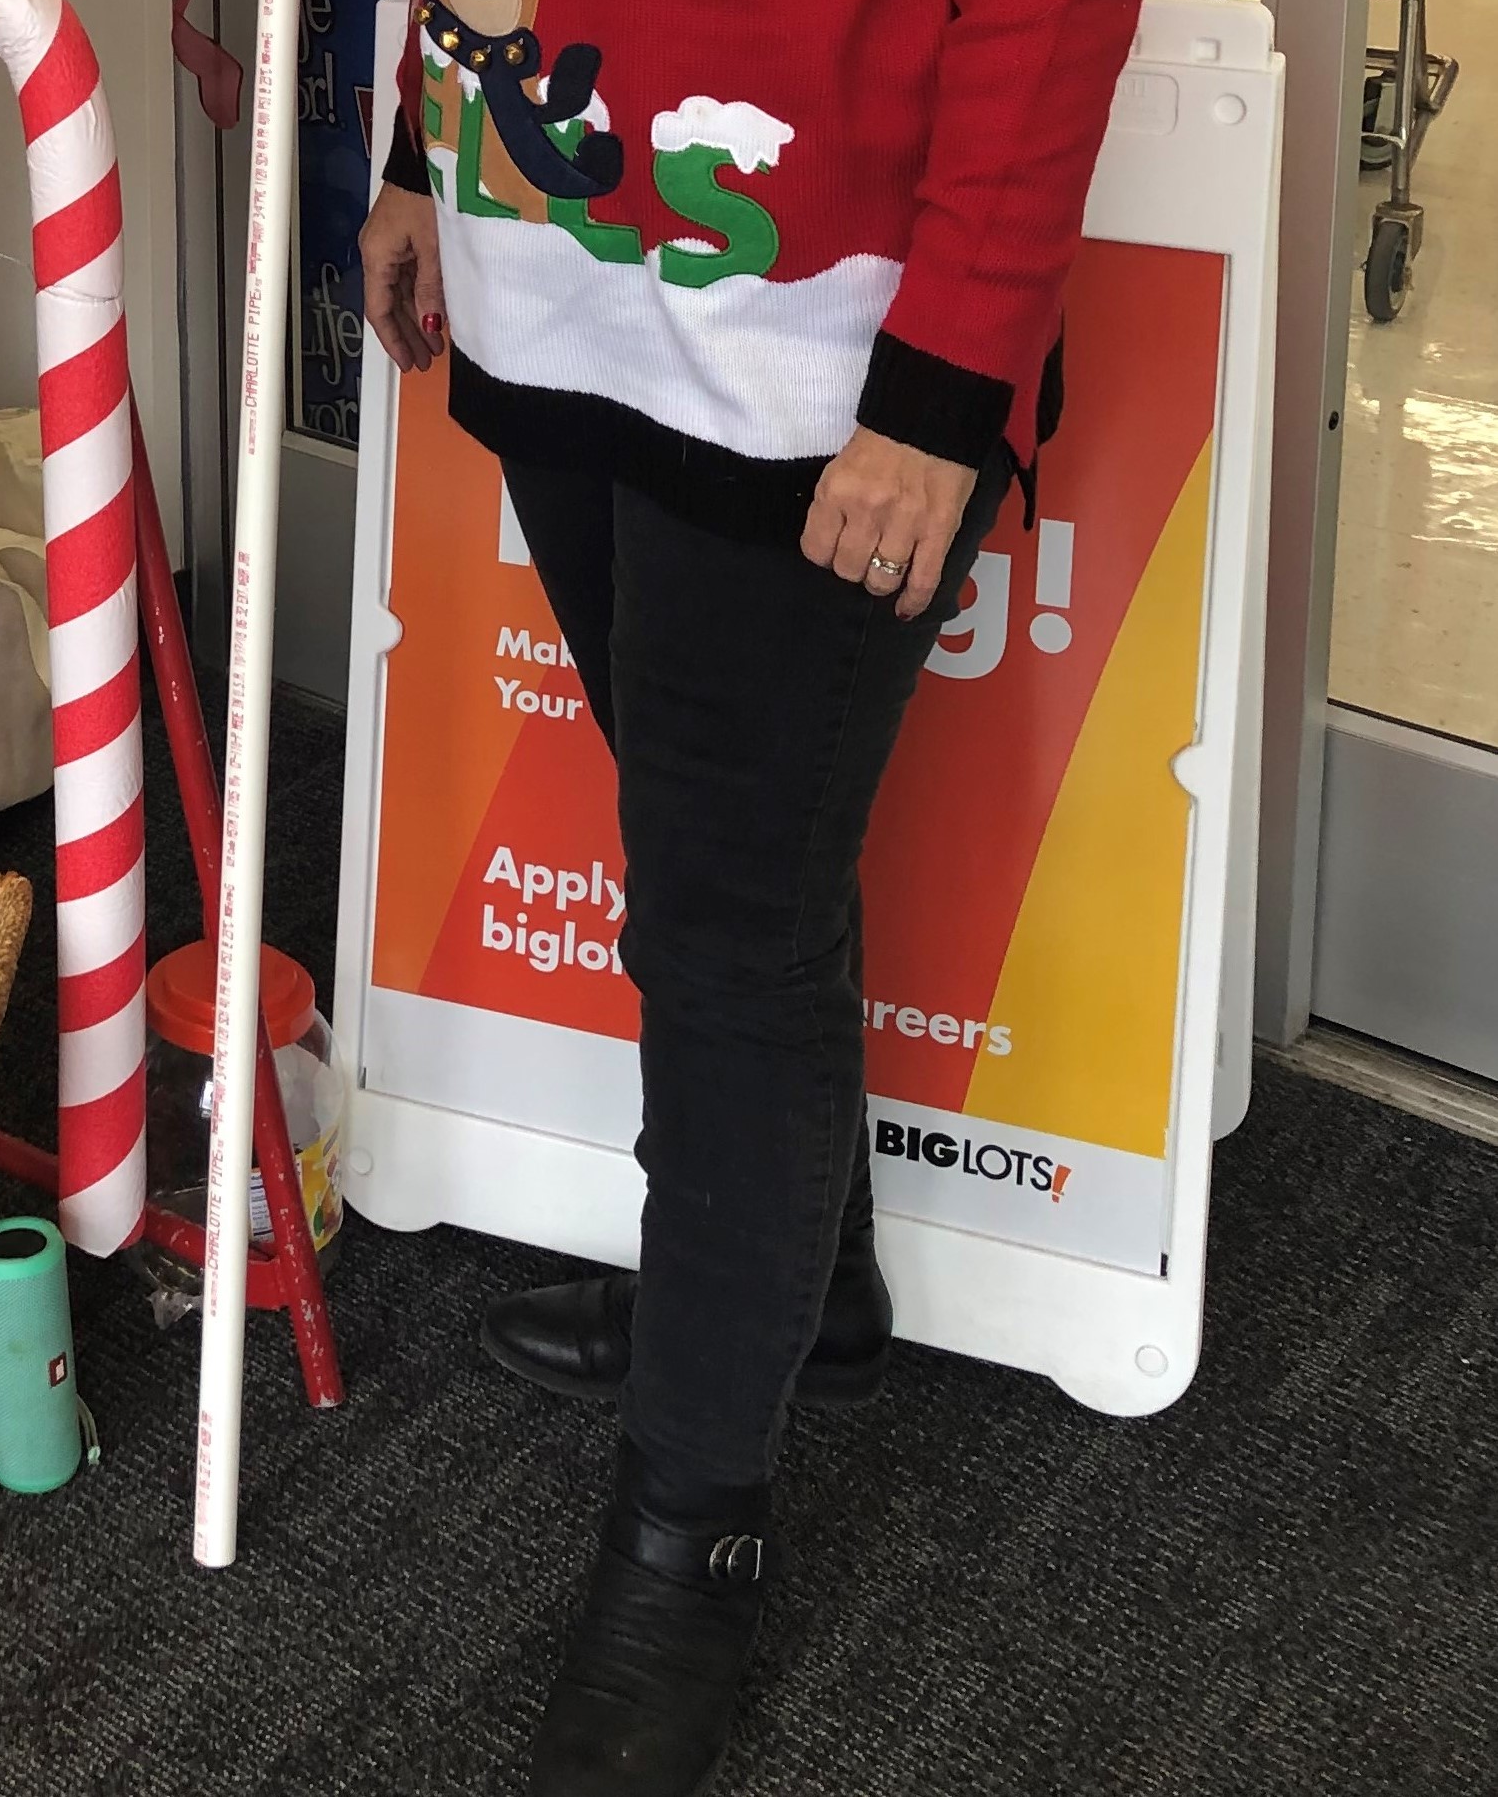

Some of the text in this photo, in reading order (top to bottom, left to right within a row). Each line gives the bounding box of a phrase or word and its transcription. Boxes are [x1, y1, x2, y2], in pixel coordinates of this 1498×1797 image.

[248, 290, 262, 326] PIPE
[245, 332, 260, 408] CHARLOTTE
[494, 677, 583, 721] Your
[483, 846, 626, 921] Apply
[211, 1152, 224, 1188] PIPE
[207, 1191, 223, 1270] CHARLOTTE
